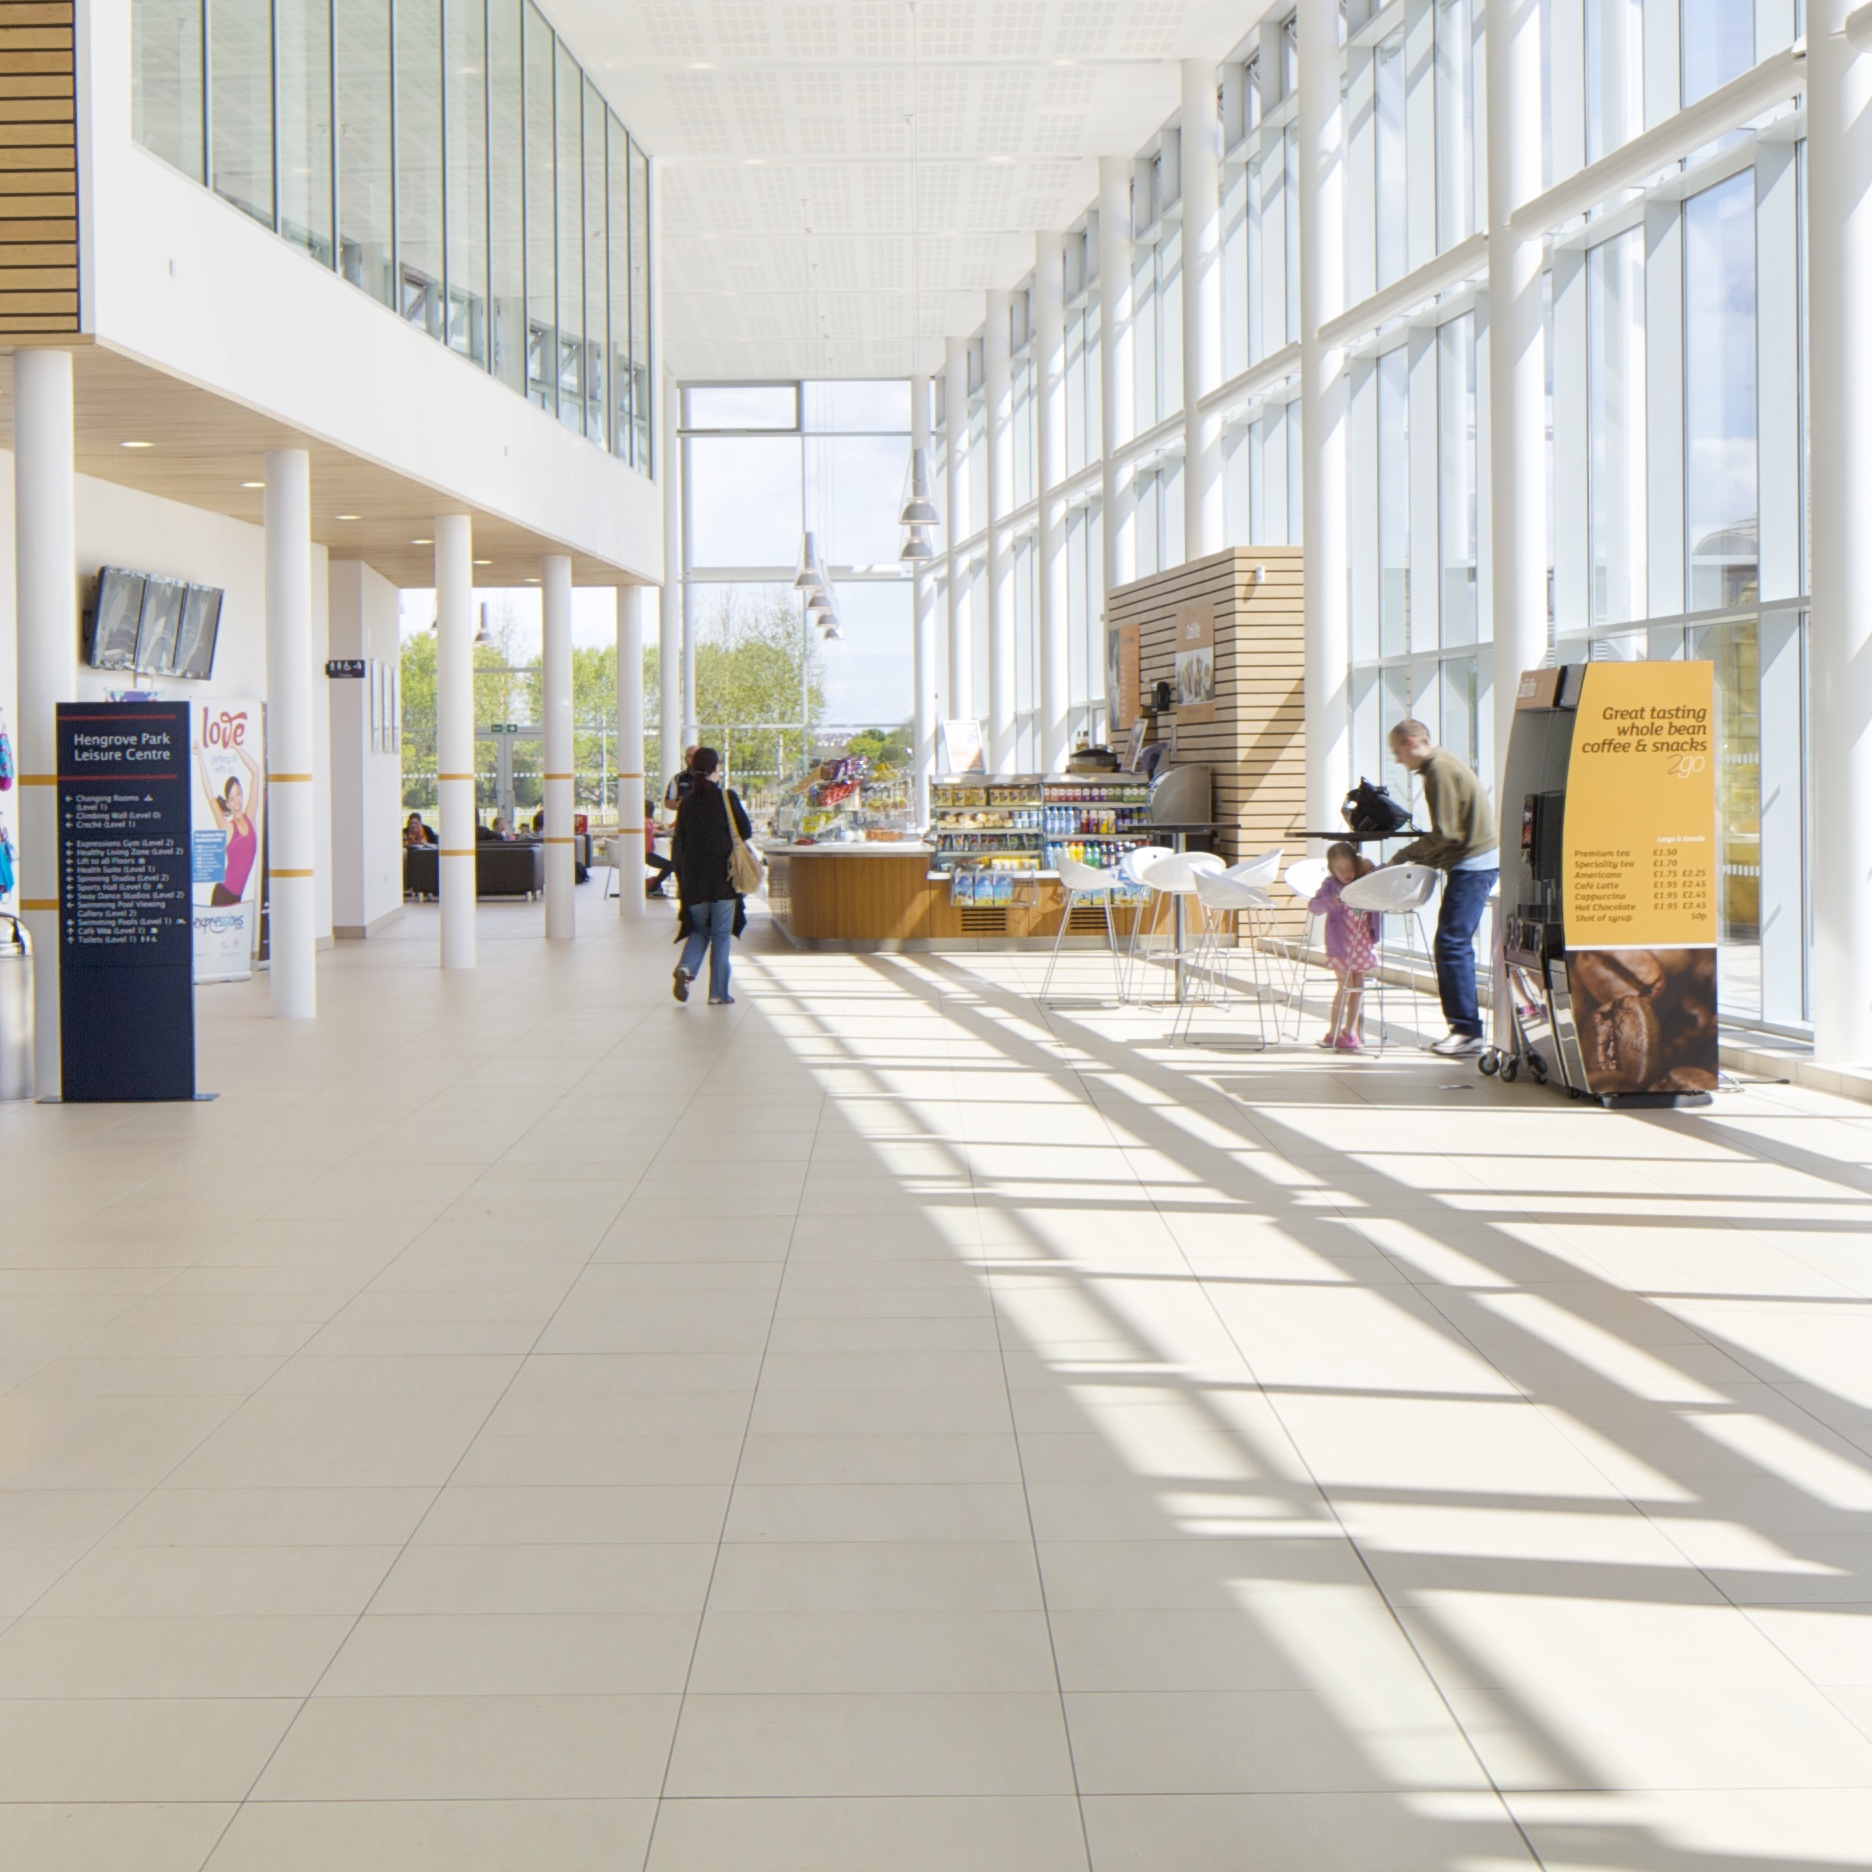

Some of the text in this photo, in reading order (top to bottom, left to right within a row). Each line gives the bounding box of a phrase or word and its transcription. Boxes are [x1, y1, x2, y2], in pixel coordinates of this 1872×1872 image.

[1602, 705, 1707, 723] Great tasting
[202, 706, 248, 749] love
[1617, 721, 1707, 736] whole bean
[74, 732, 171, 748] Hengrove Park
[1582, 738, 1707, 754] coffee & snacks
[74, 748, 171, 761] Leisure Centre
[1667, 754, 1705, 779] 2go
[76, 794, 139, 803] Changing Rooms
[76, 803, 98, 811] (Level
[76, 812, 110, 821] Climbing
[129, 811, 151, 819] (Level
[77, 840, 121, 848] Expressions
[122, 839, 140, 848] Gym
[77, 849, 105, 857] Healthy
[106, 849, 129, 857] Living
[1653, 849, 1678, 857] £1.50
[1574, 859, 1678, 869] Speciality tea £1.70
[1574, 869, 1706, 879] Americano £1.75 £2.25
[1596, 882, 1619, 890] Latte
[1654, 881, 1678, 889] £1.95
[1682, 880, 1706, 888] £2.45
[1575, 891, 1706, 901] Cappuccino £1.95 £2.45
[135, 901, 166, 909] Viewing
[1592, 903, 1636, 911] Chocolate
[1683, 902, 1706, 910] £2.45
[77, 919, 116, 927] Swimming
[1597, 914, 1607, 922] of
[1608, 915, 1632, 923] syrup
[1691, 913, 1707, 921] 50p
